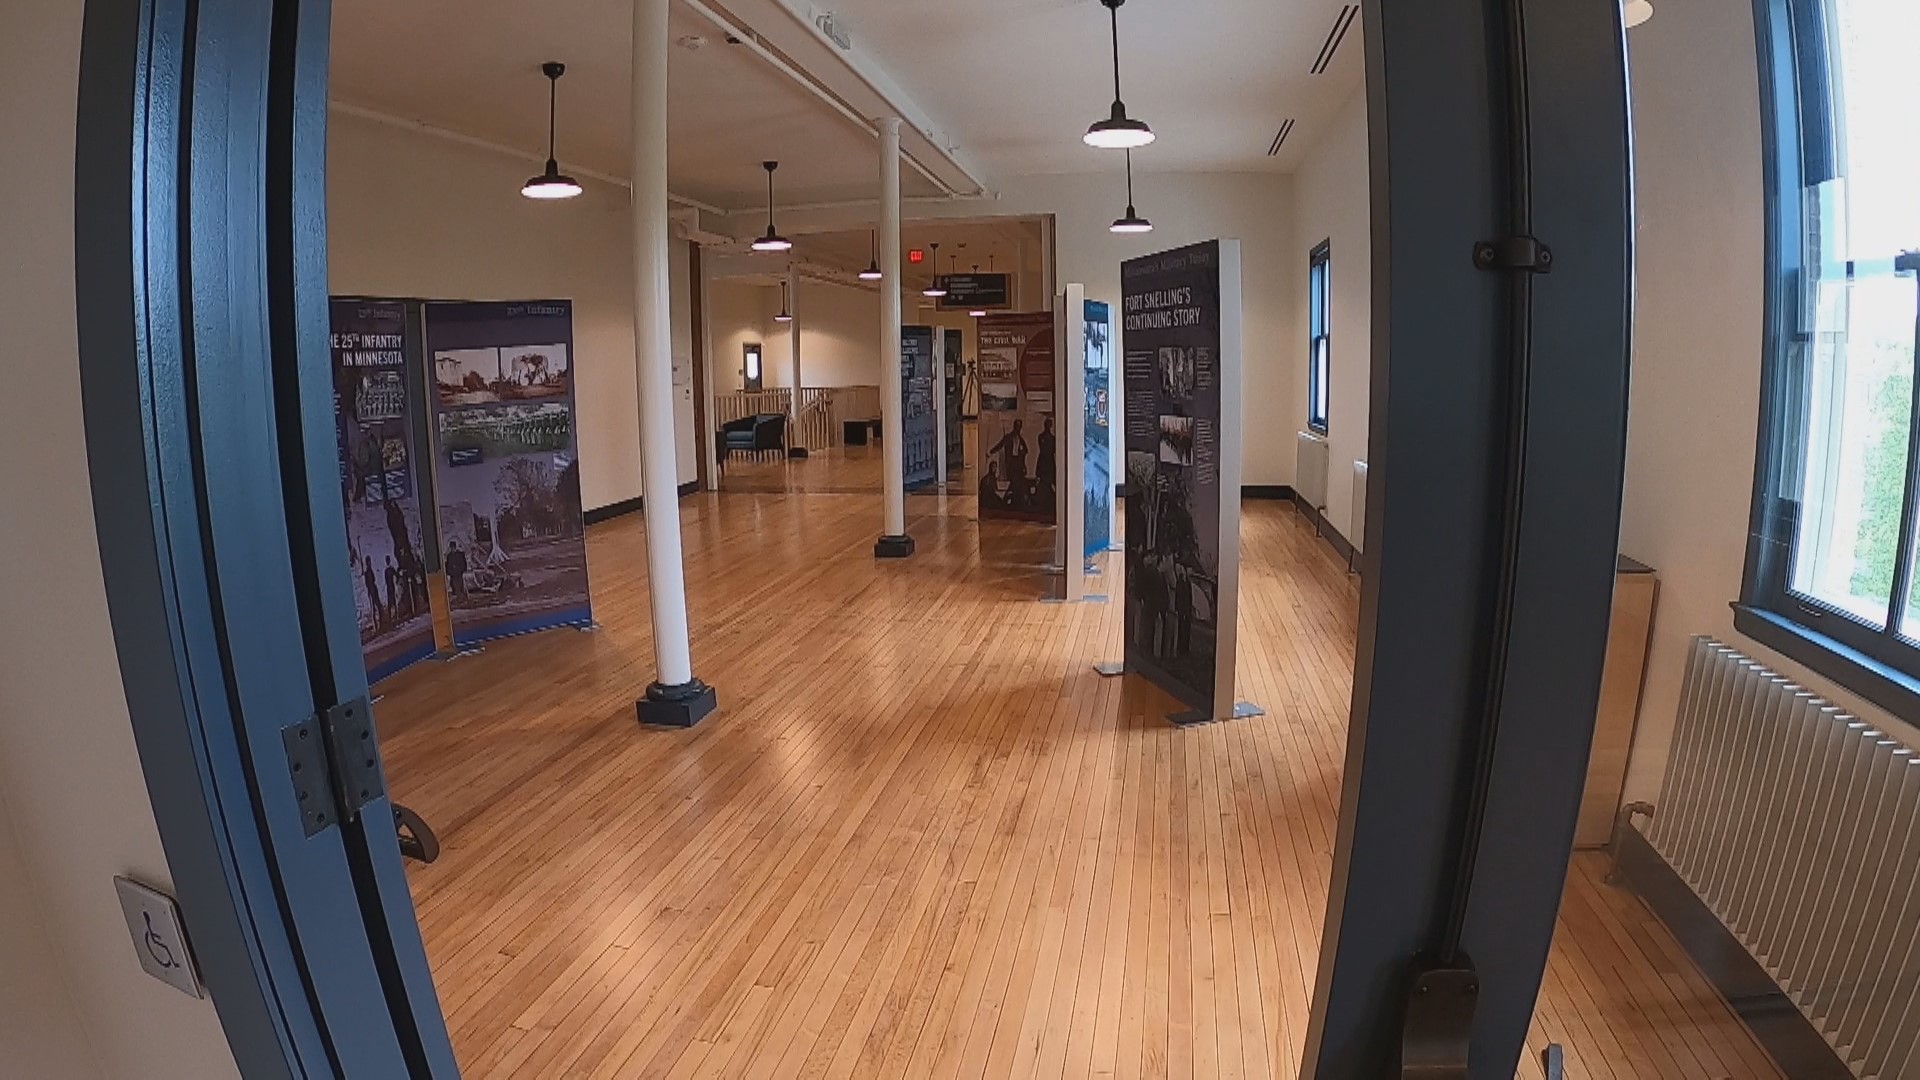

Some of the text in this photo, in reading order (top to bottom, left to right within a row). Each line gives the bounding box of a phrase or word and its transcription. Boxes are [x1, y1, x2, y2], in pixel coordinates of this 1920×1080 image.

[1125, 295, 1143, 312] FORT
[1144, 286, 1192, 309] SNELLING'S
[1125, 307, 1201, 331] CONTINUING STORY
[361, 334, 402, 349] INFANTRY
[342, 350, 403, 367] IN MINNESOTA
